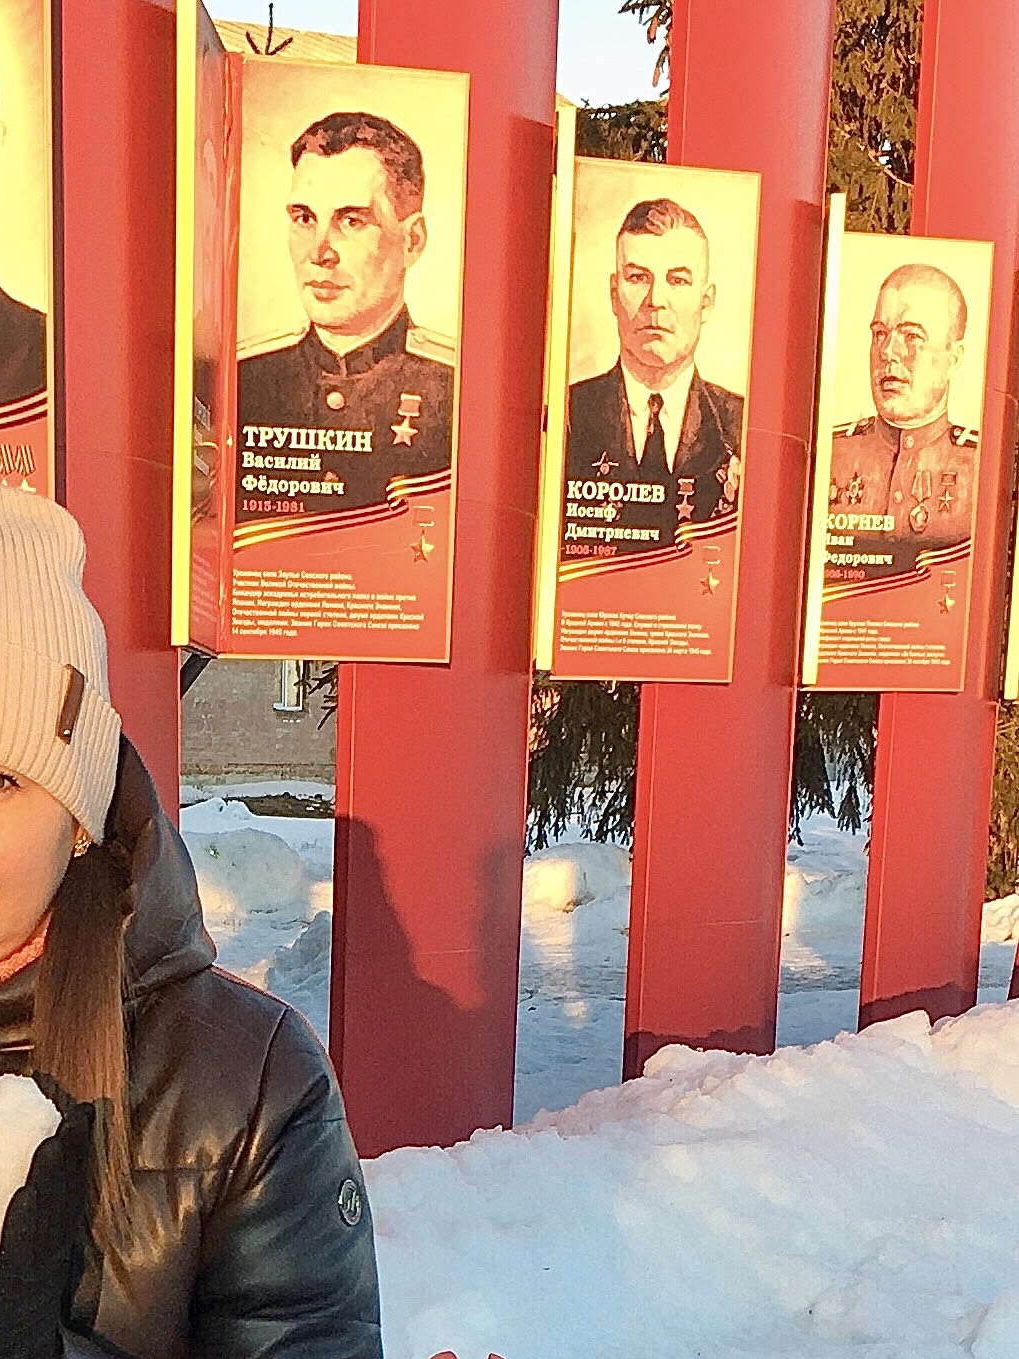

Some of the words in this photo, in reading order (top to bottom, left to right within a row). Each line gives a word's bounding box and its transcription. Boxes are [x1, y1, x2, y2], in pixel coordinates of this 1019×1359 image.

[242, 425, 373, 452] ТРУШКИН
[242, 451, 321, 471] Василий
[242, 474, 345, 497] Фёдорович
[567, 480, 665, 502] КОРОЛЕВ
[242, 499, 305, 513] 1915-1981
[566, 503, 617, 522] Иосиф
[827, 513, 895, 530] КОРНЕВ
[565, 523, 660, 542] Дмитриевич
